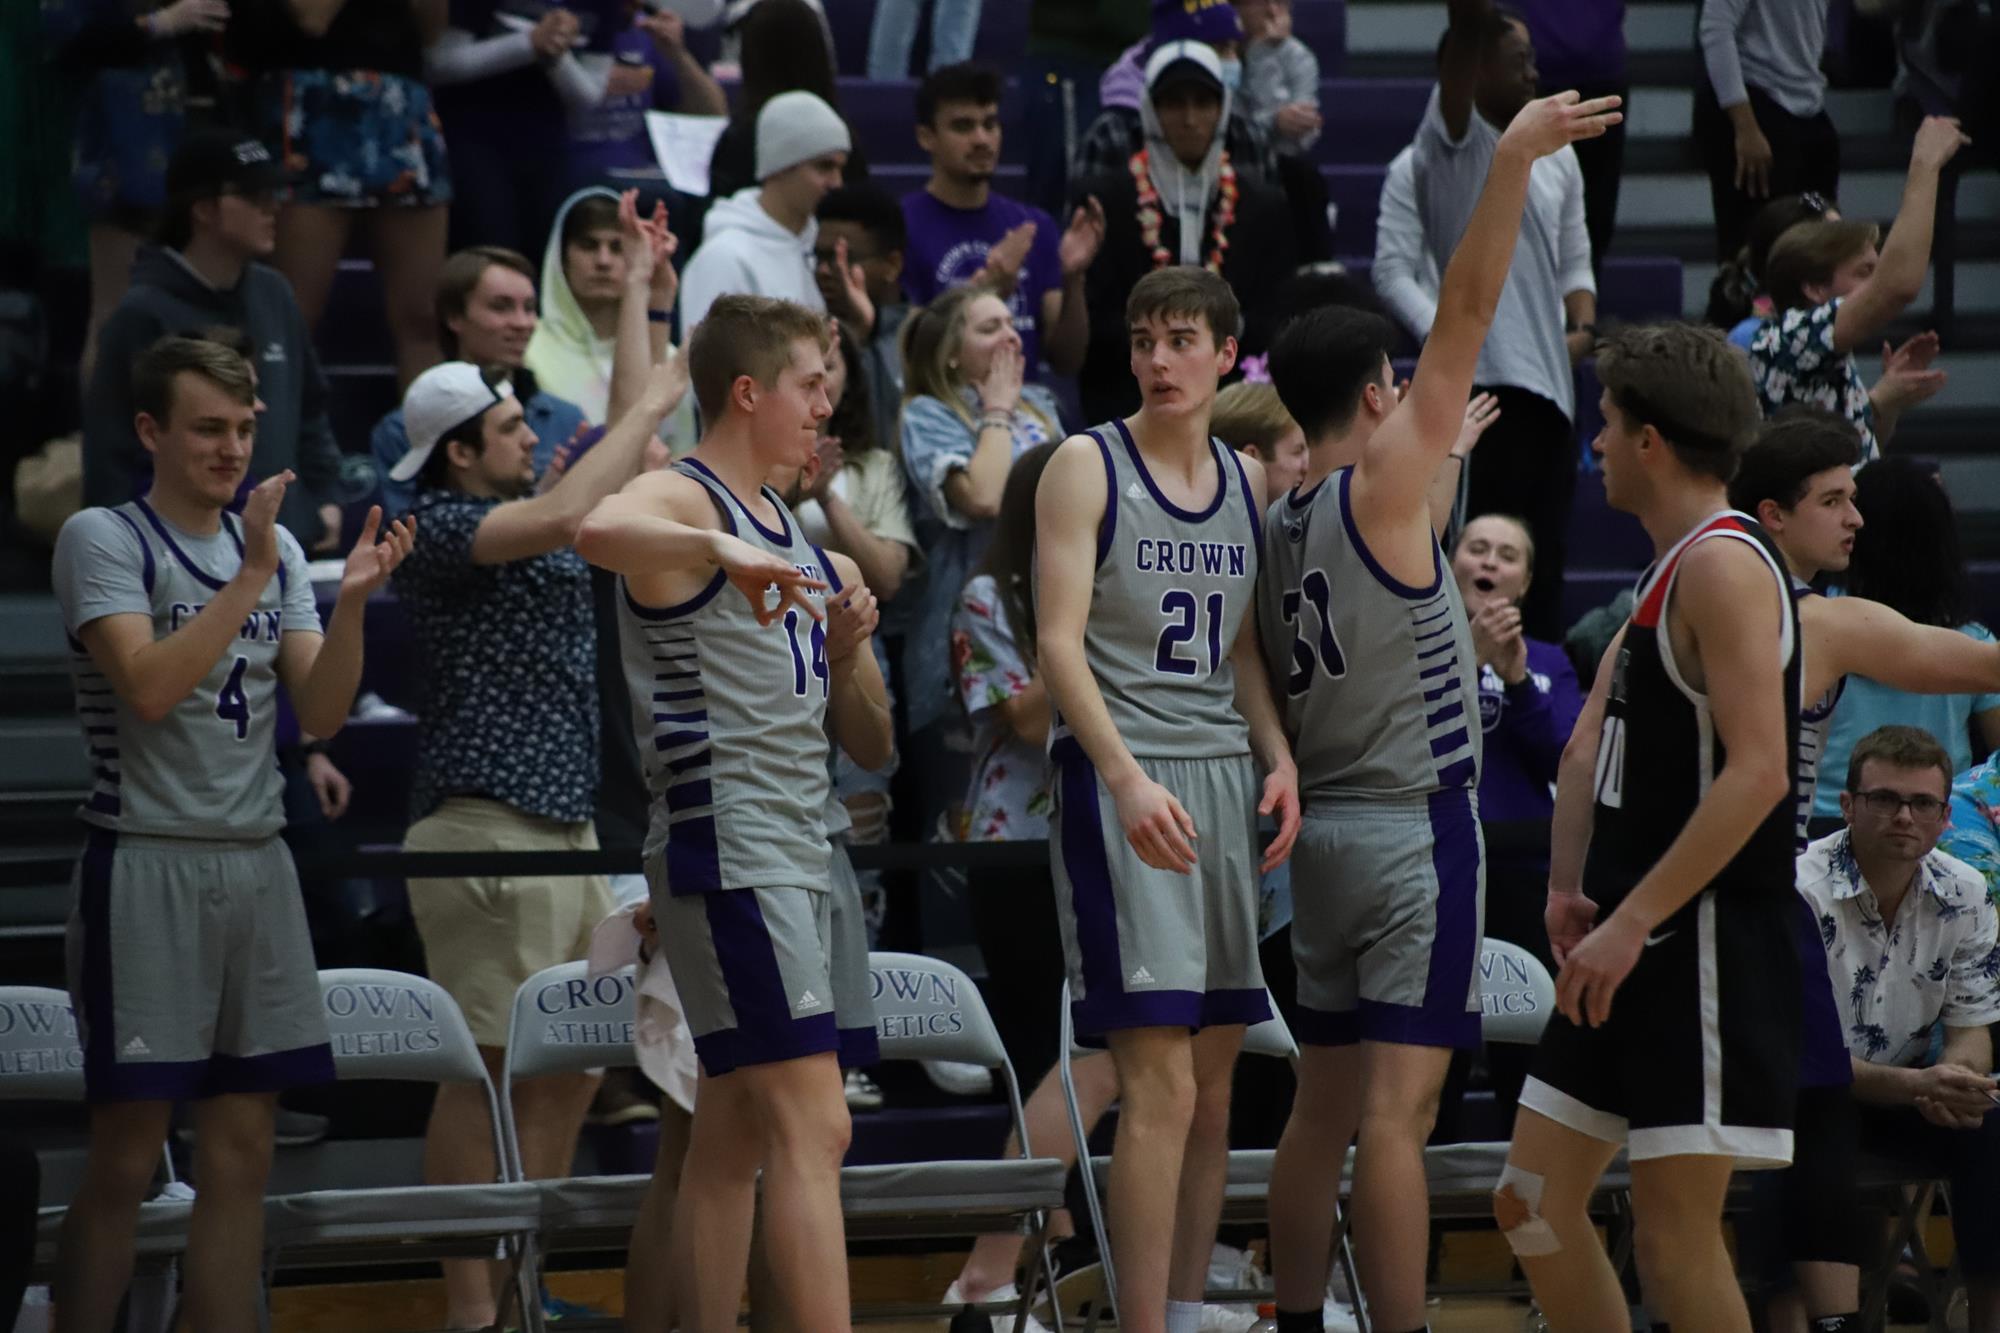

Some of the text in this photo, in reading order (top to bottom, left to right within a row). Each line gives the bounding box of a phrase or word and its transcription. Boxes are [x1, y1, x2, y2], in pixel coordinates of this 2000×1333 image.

[1136, 539, 1246, 577] CROWN
[171, 603, 282, 642] CWN
[784, 608, 829, 700] 14
[1155, 590, 1224, 675] 21
[215, 655, 250, 740] 4
